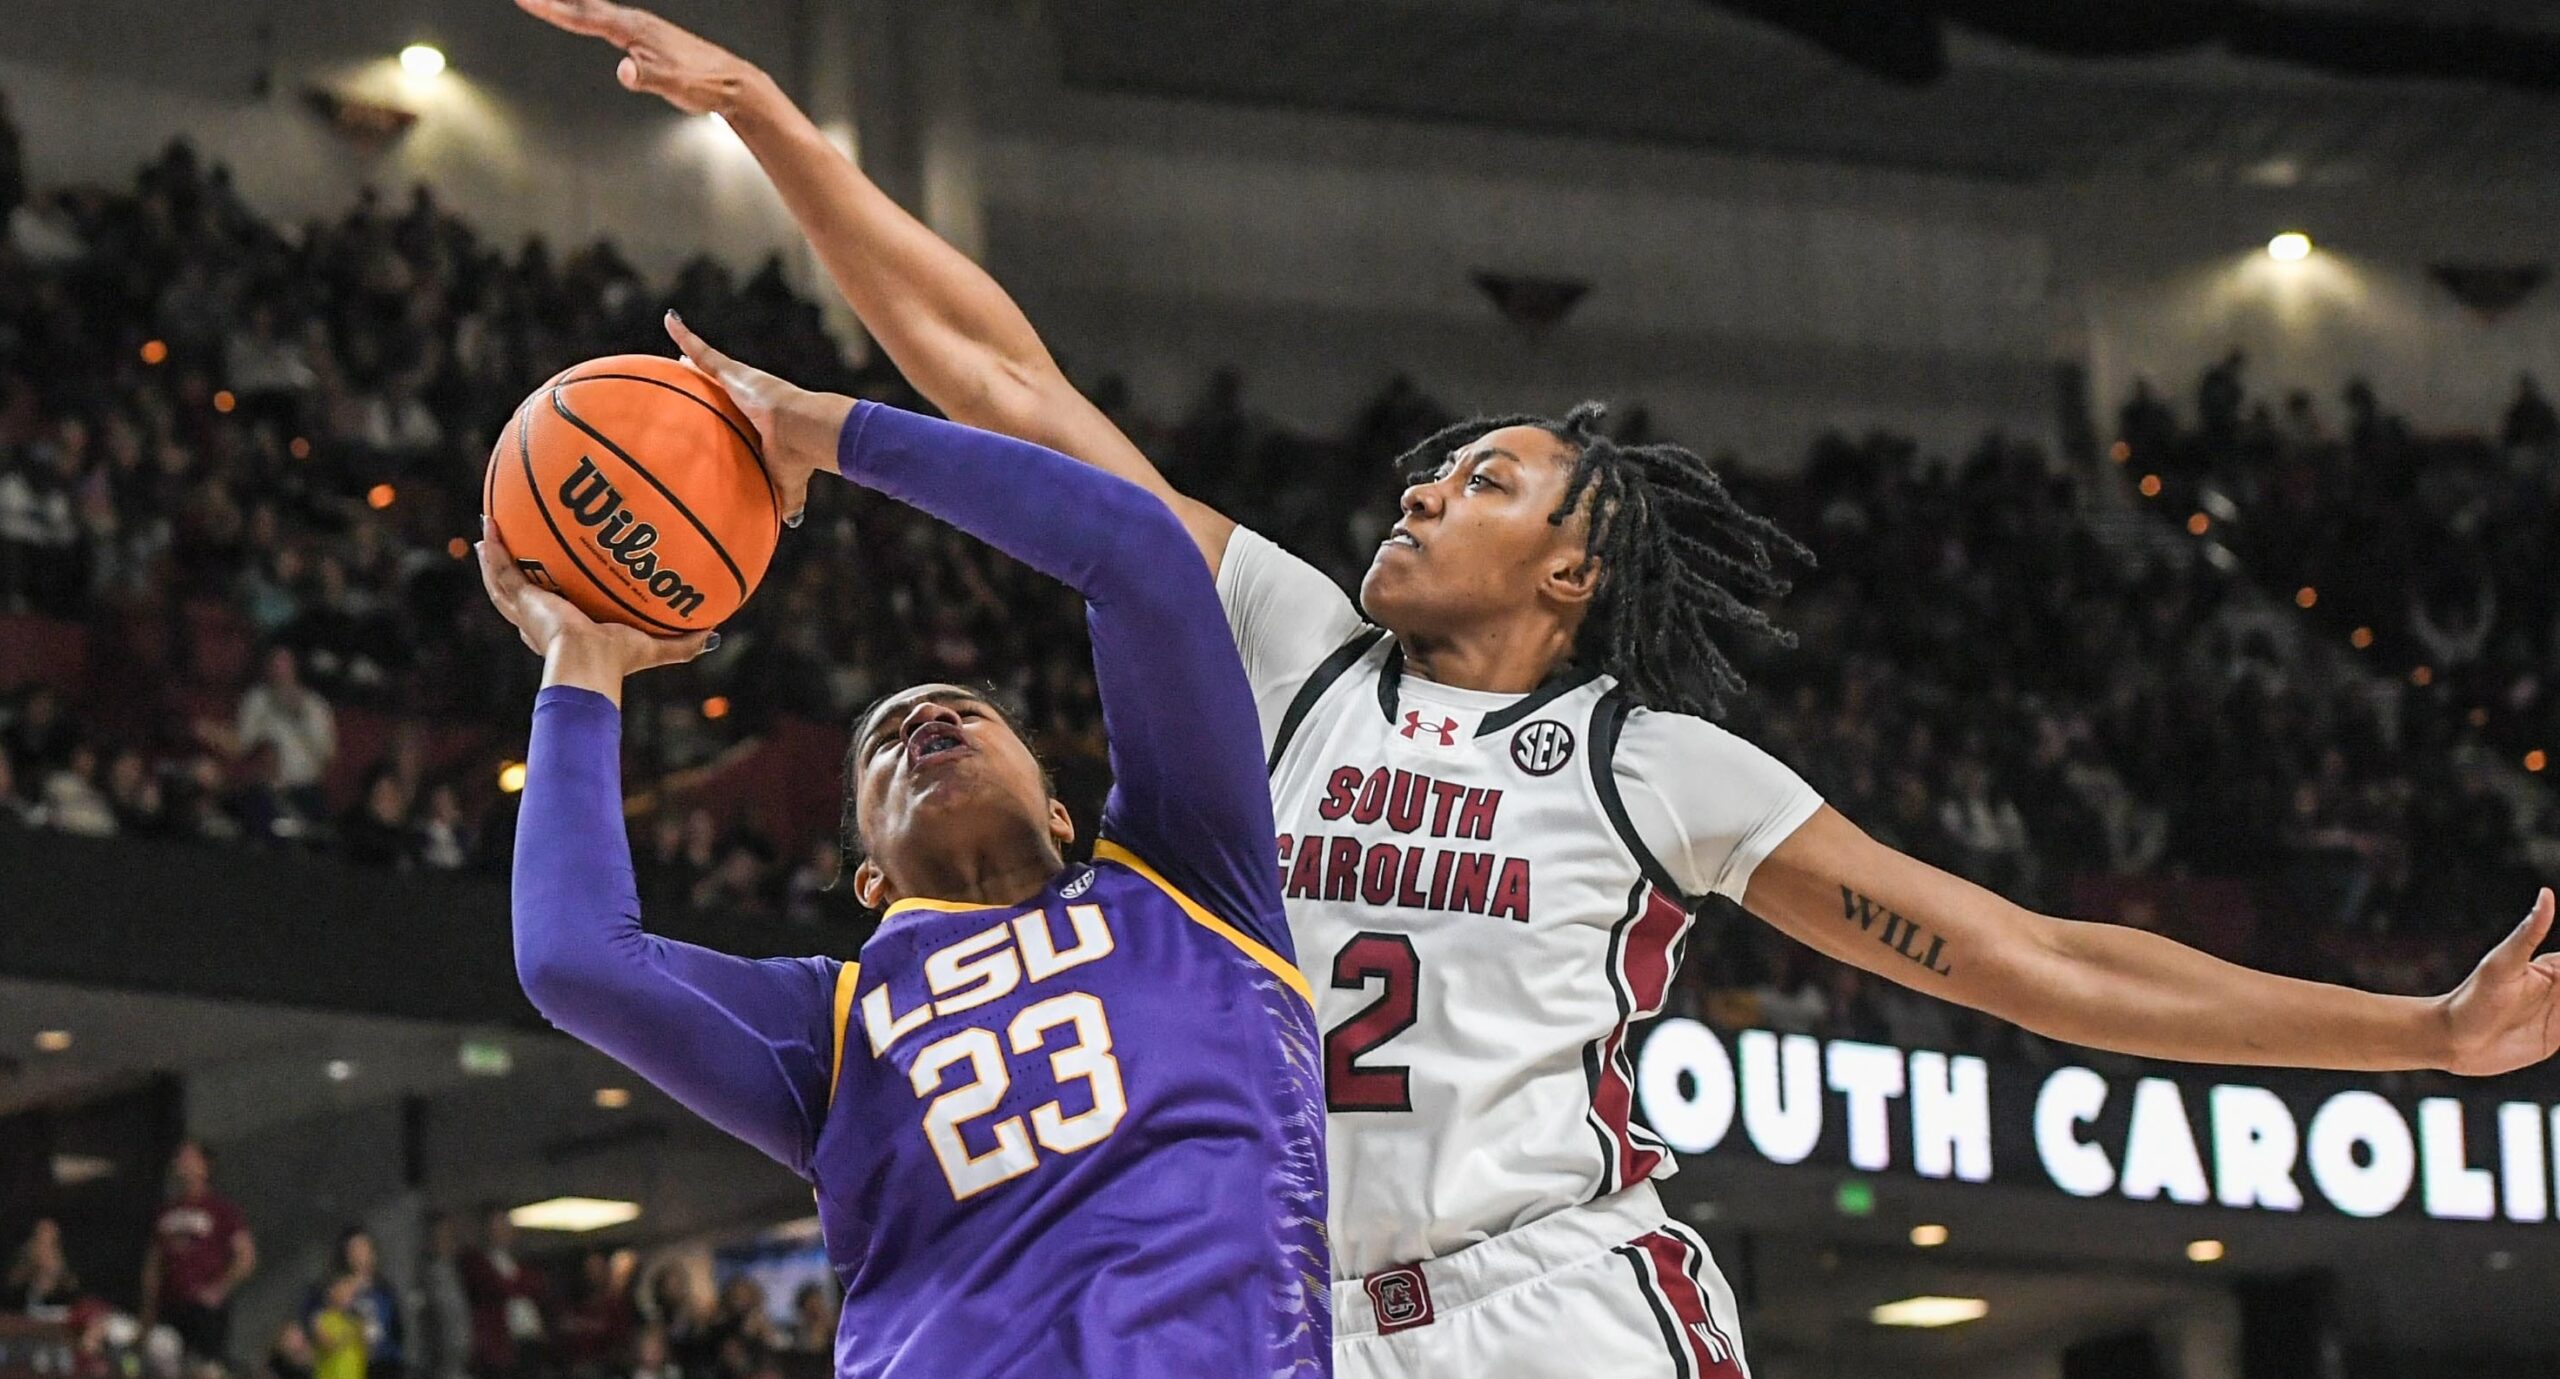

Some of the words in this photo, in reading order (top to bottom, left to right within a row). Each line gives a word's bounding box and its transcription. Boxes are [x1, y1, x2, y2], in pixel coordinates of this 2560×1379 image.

[558, 455, 705, 618] Wilson
[1318, 765, 1504, 841] SOUTH
[1515, 721, 1571, 771] SEC
[861, 903, 1115, 1059] LSU
[1840, 884, 1952, 977] WILL
[908, 991, 1129, 1201] 23
[1324, 931, 1421, 1113] 2
[2033, 1066, 2560, 1223] CAROLI
